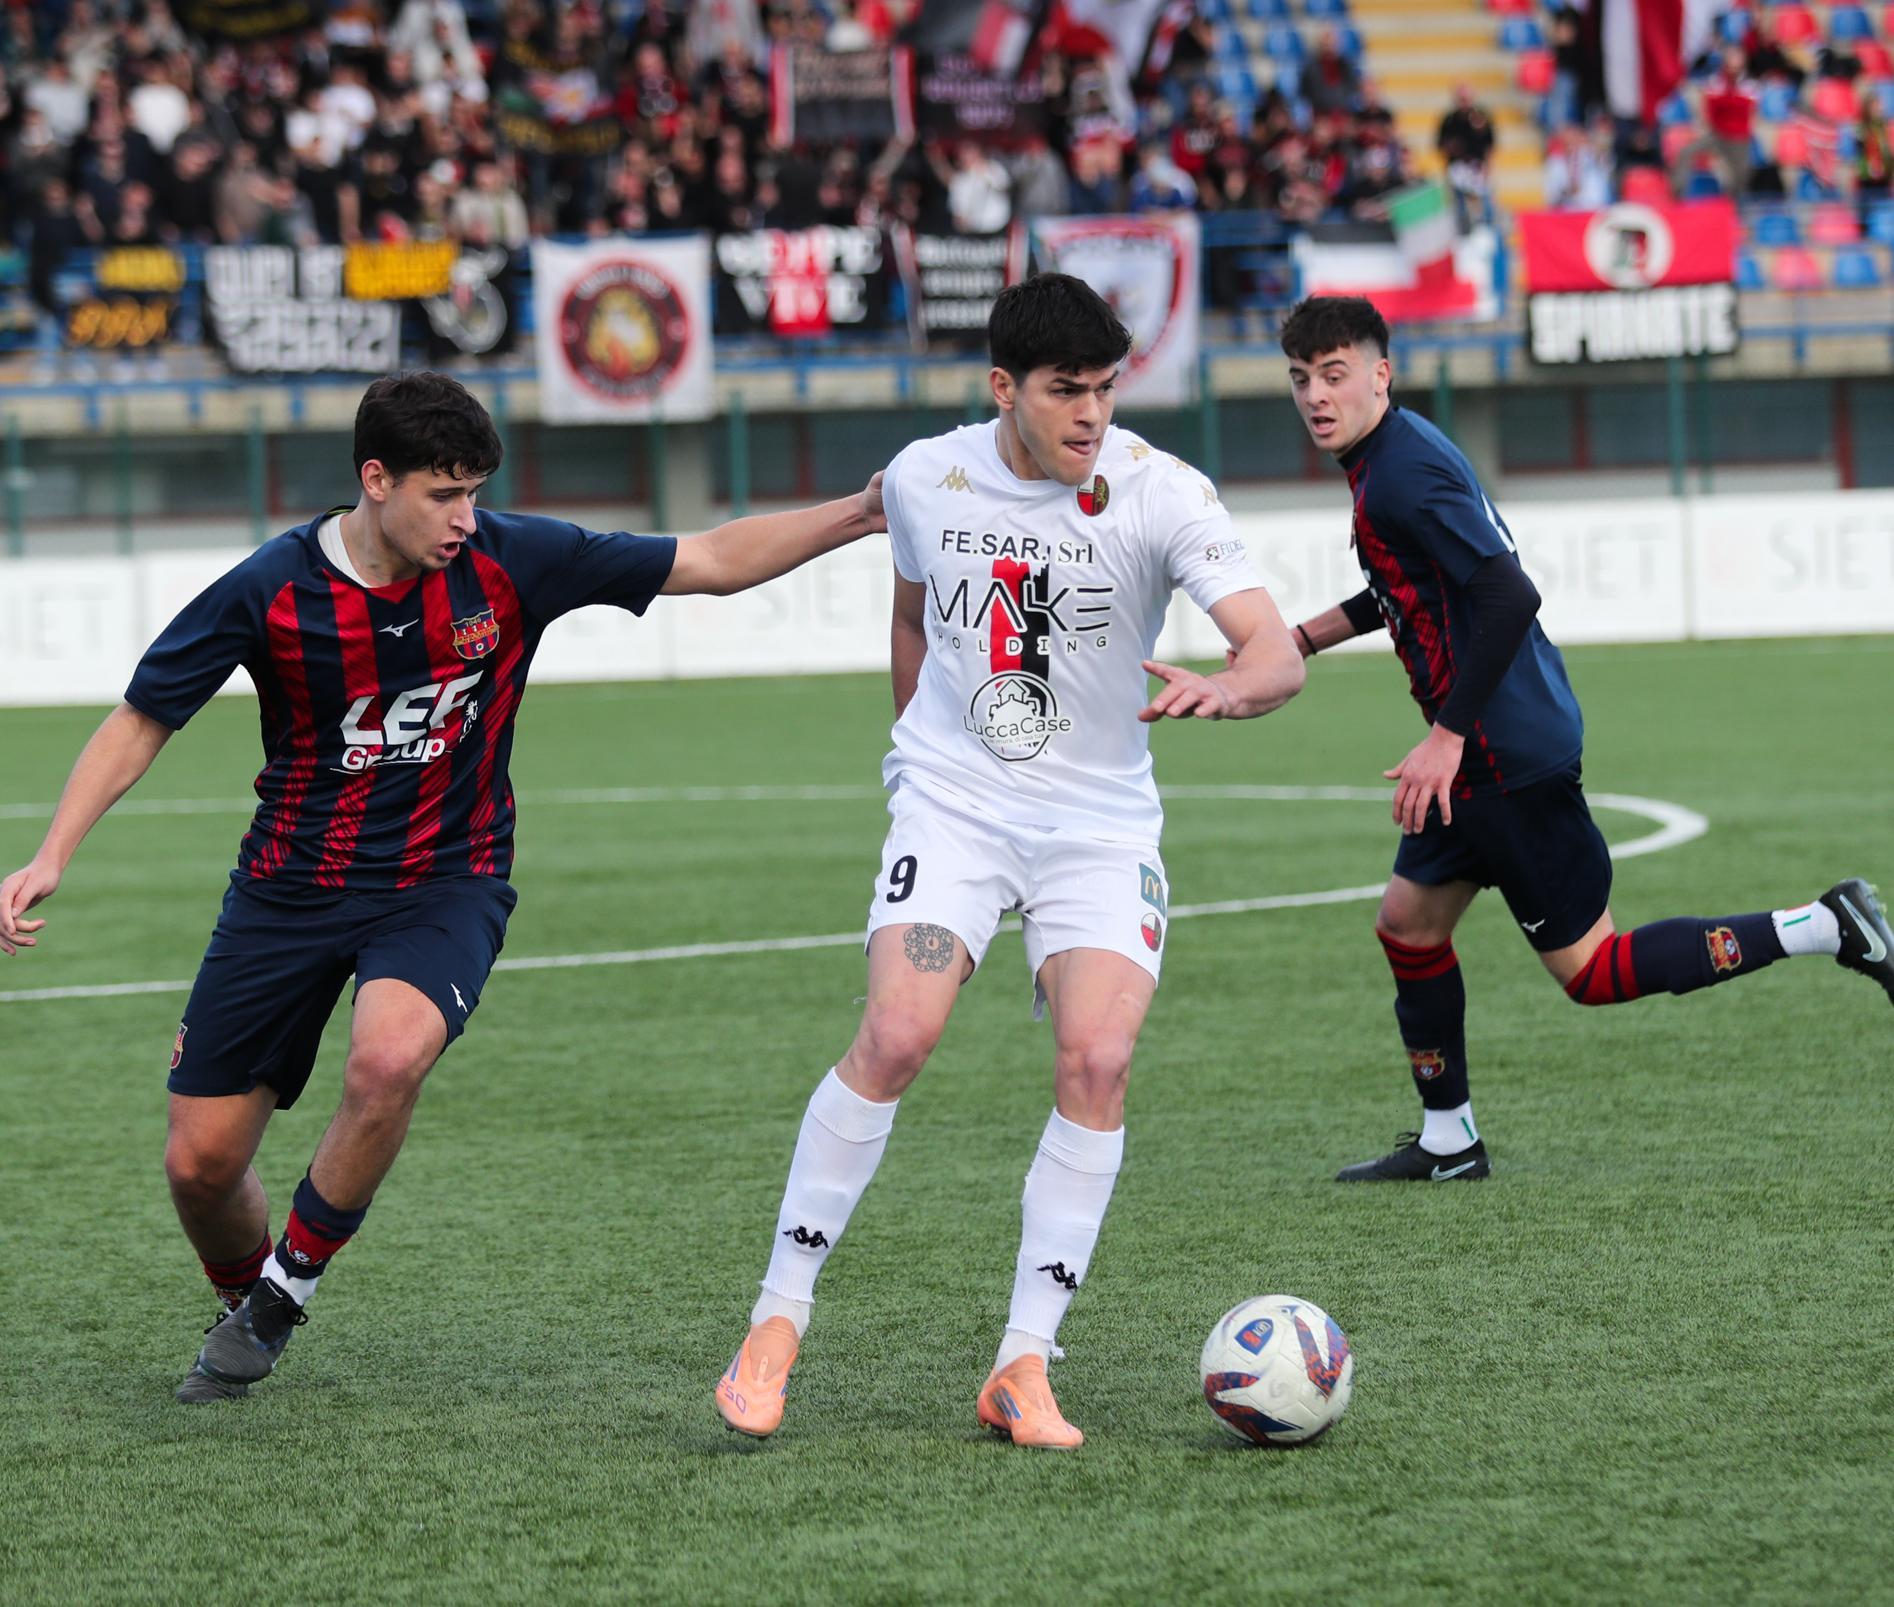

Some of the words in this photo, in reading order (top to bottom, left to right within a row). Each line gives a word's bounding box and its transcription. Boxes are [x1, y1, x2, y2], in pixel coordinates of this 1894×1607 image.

[1058, 541, 1093, 564] Srl
[929, 575, 1114, 632] MAKE
[937, 631, 1107, 653] HOLDING
[339, 670, 484, 745] LEF
[964, 716, 1071, 738] LuccaCase
[886, 855, 918, 904] 9
